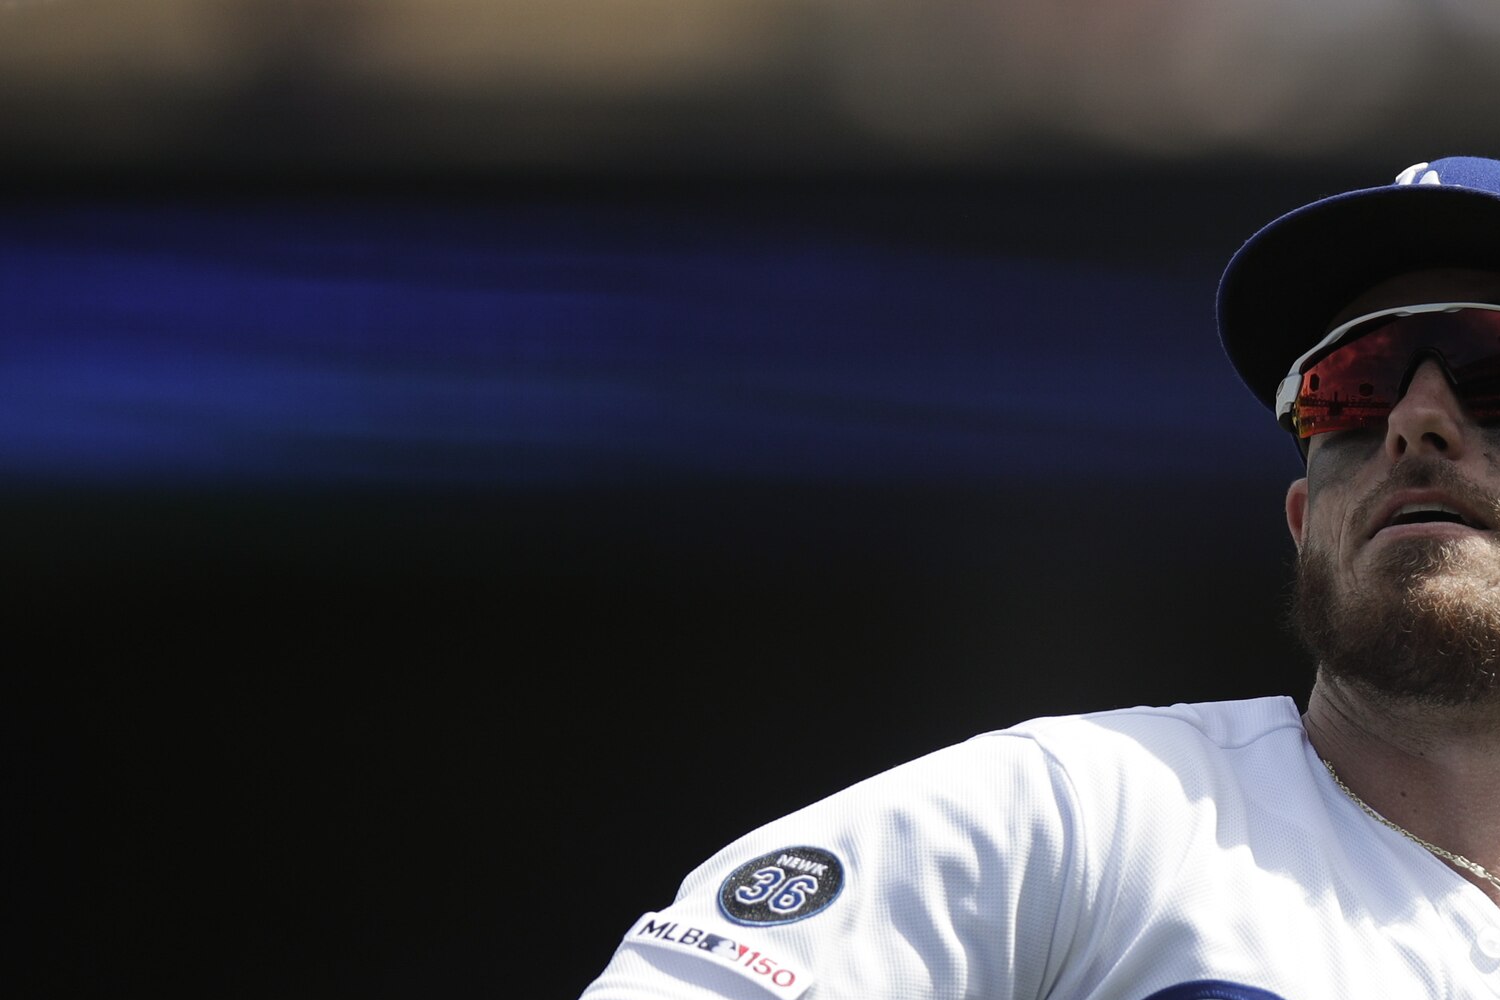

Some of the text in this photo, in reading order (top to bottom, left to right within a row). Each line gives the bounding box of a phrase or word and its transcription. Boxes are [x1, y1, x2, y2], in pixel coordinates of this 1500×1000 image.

[776, 854, 828, 876] NEWK
[735, 866, 818, 914] 36
[638, 919, 796, 987] MLB 150
